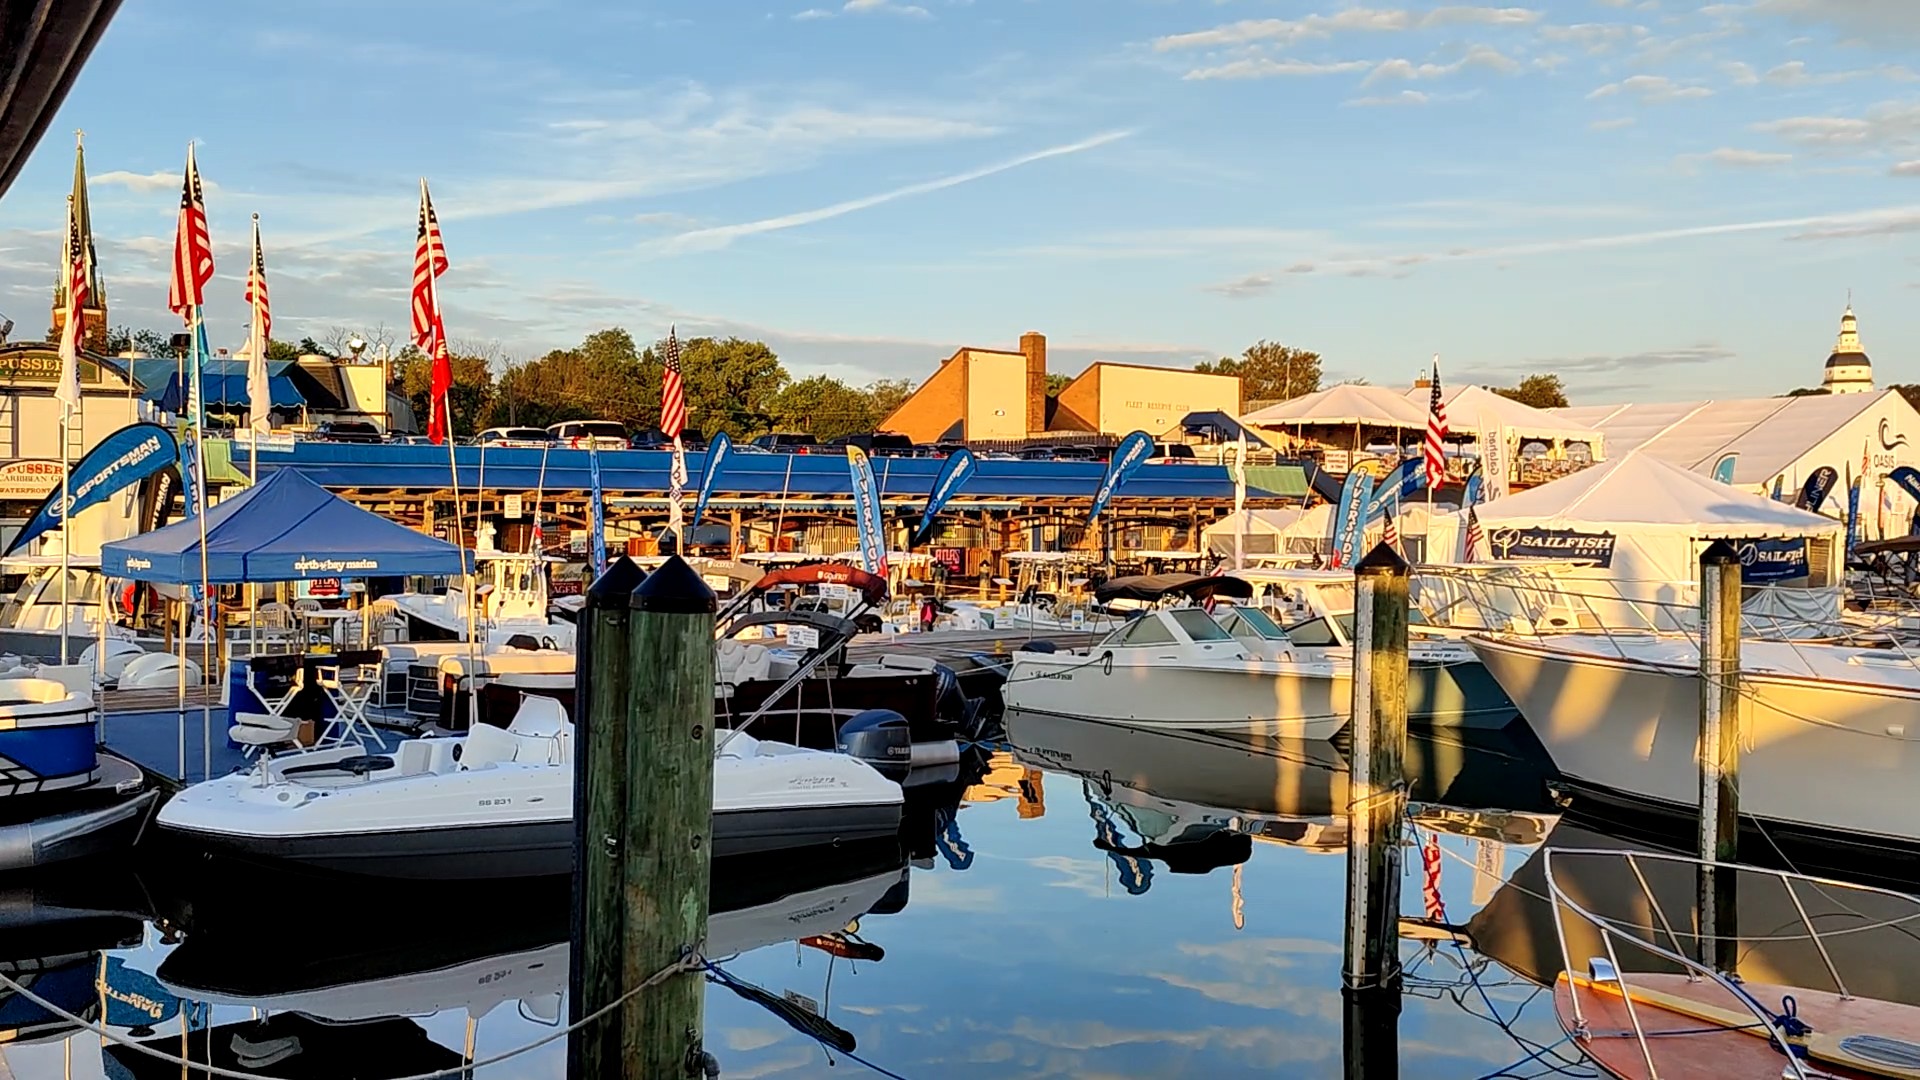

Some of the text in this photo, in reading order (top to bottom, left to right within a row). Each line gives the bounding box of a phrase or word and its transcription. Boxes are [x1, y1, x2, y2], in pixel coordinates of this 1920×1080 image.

[0, 358, 63, 371] PUSSER
[1125, 400, 1190, 412] FLEET RESERVE CLUB
[76, 435, 160, 498] SPORTSMAN
[1873, 454, 1895, 469] OASIS
[7, 463, 63, 475] PUSSER
[1341, 466, 1369, 566] RIVERSIDE
[1519, 535, 1613, 549] SAILFISH
[1573, 548, 1611, 556] BOATS
